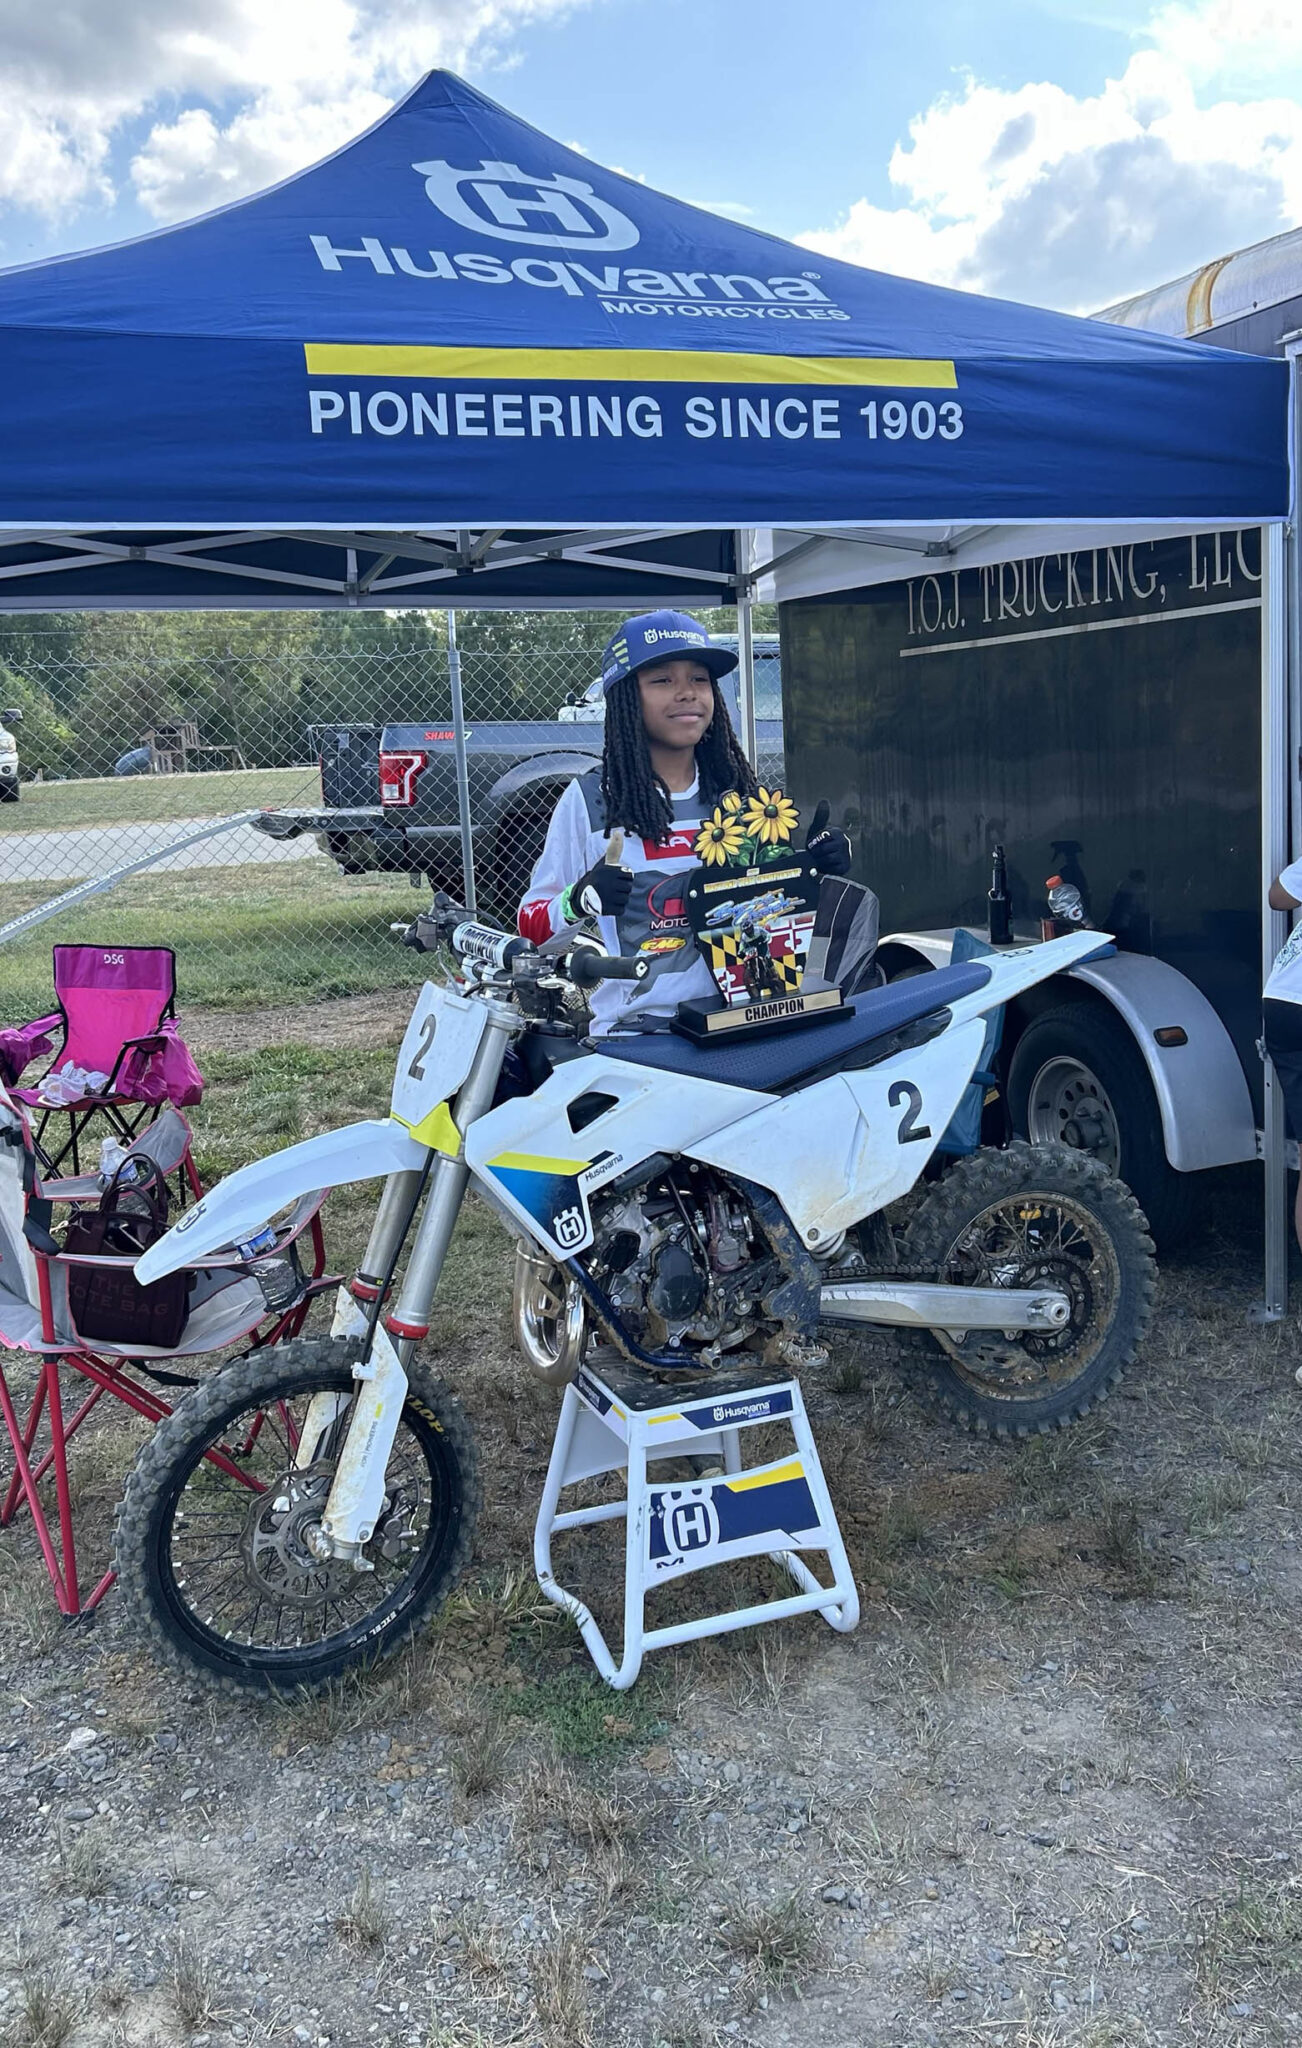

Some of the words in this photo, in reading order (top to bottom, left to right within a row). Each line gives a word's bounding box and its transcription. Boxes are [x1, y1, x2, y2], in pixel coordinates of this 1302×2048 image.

[309, 234, 823, 302] Husqvarna
[601, 301, 851, 322] MOTORCYCLES
[308, 390, 662, 438] PIONEERING
[685, 397, 840, 440] SINCE
[859, 401, 964, 440] 1903
[103, 953, 124, 965] DSG
[745, 998, 805, 1022] CHAMPION
[408, 1013, 437, 1081] 2
[887, 1080, 932, 1145] 2
[584, 1154, 624, 1182] Husqvarna
[72, 1284, 112, 1308] OTE
[120, 1299, 169, 1315] BAG
[724, 1402, 771, 1418] Husqvarna
